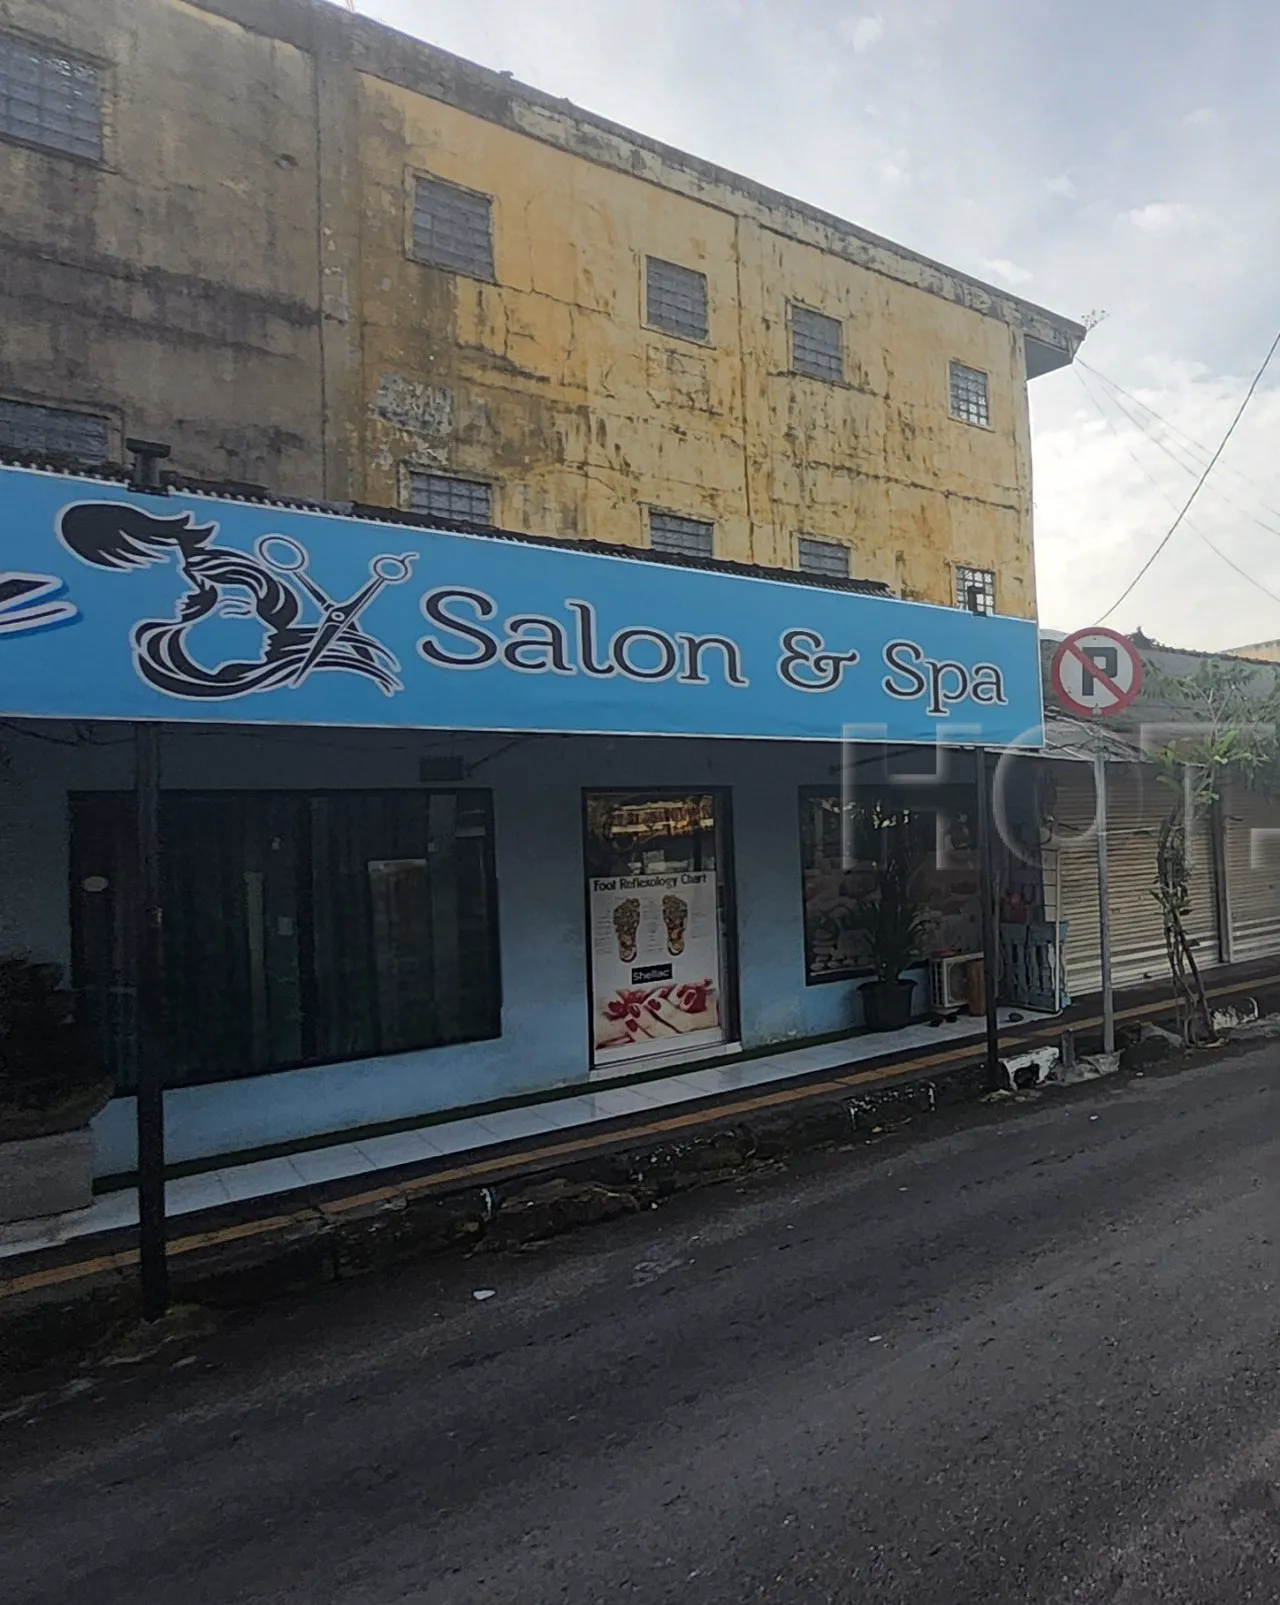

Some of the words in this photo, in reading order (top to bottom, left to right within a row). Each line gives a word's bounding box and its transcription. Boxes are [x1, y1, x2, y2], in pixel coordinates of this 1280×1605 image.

[417, 586, 750, 688] Salon
[777, 628, 859, 693] &
[881, 639, 1008, 717] Spa
[1081, 646, 1118, 697] P
[593, 879, 617, 892] Foot
[619, 876, 678, 890] Reflexology
[680, 872, 707, 885] Chart
[632, 968, 670, 981] Shellac
